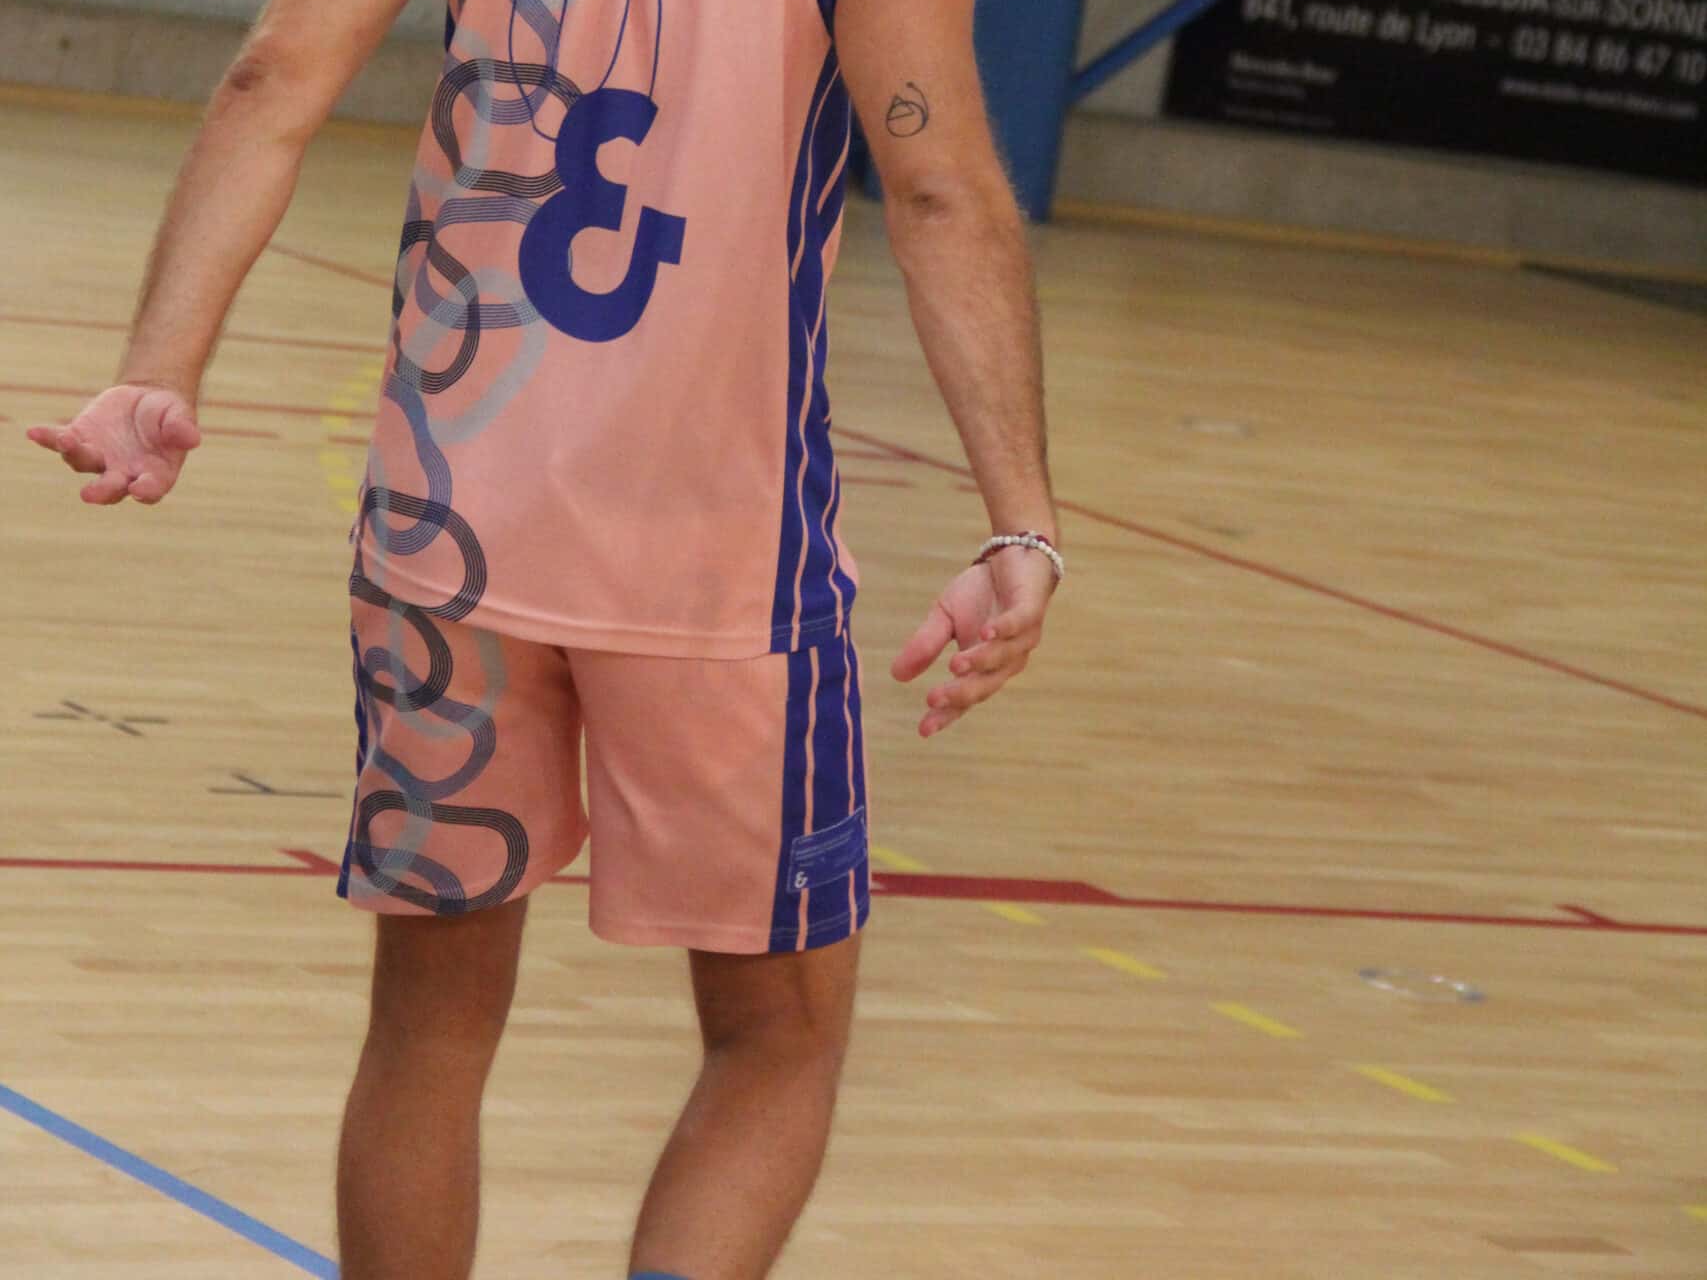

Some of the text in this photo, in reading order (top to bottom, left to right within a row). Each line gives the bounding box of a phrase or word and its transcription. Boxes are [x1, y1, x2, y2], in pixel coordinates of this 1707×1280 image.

[1302, 0, 1375, 37] route
[1377, 7, 1412, 44] de
[1415, 10, 1478, 54] Lyon
